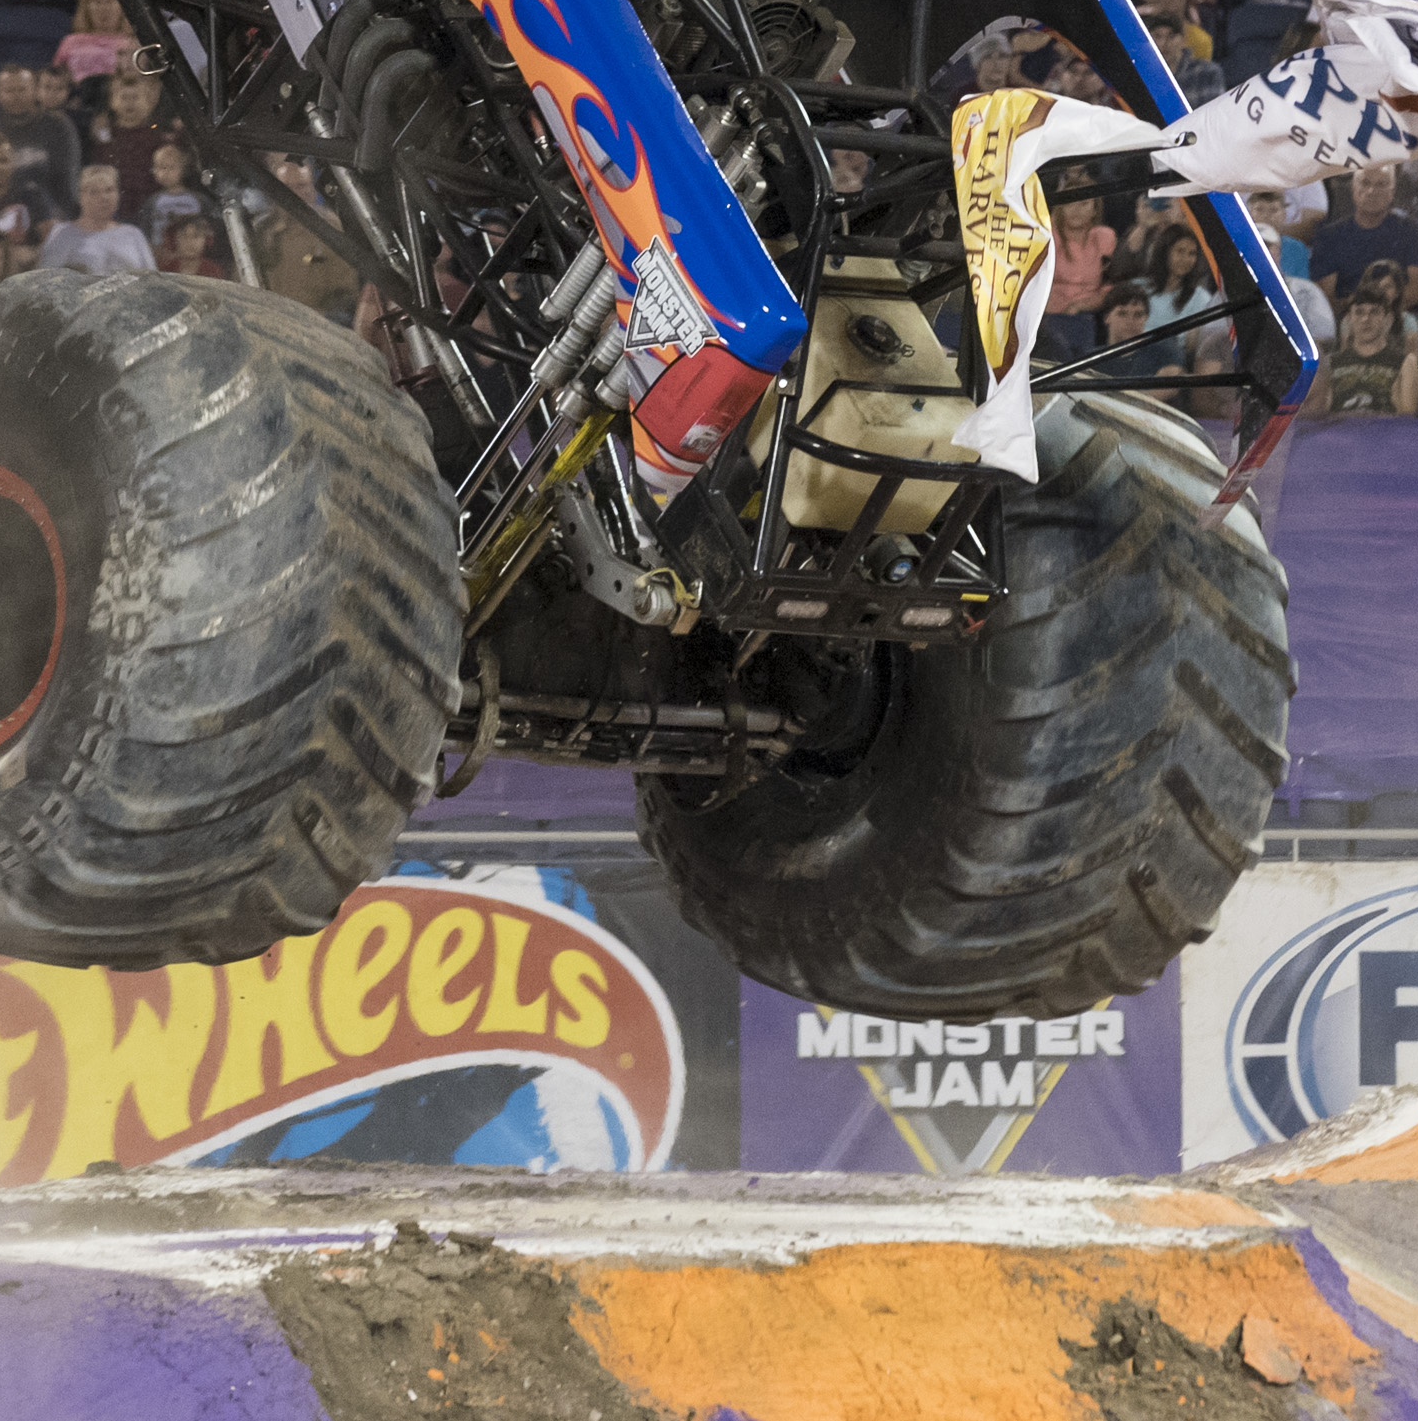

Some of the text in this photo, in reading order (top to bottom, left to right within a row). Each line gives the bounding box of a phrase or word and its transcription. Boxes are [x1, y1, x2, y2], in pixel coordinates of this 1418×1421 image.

[635, 250, 704, 353] MONSTER
[635, 290, 675, 343] JAM
[797, 1009, 1125, 1059] MONSTER
[889, 1061, 1035, 1108] JAM
